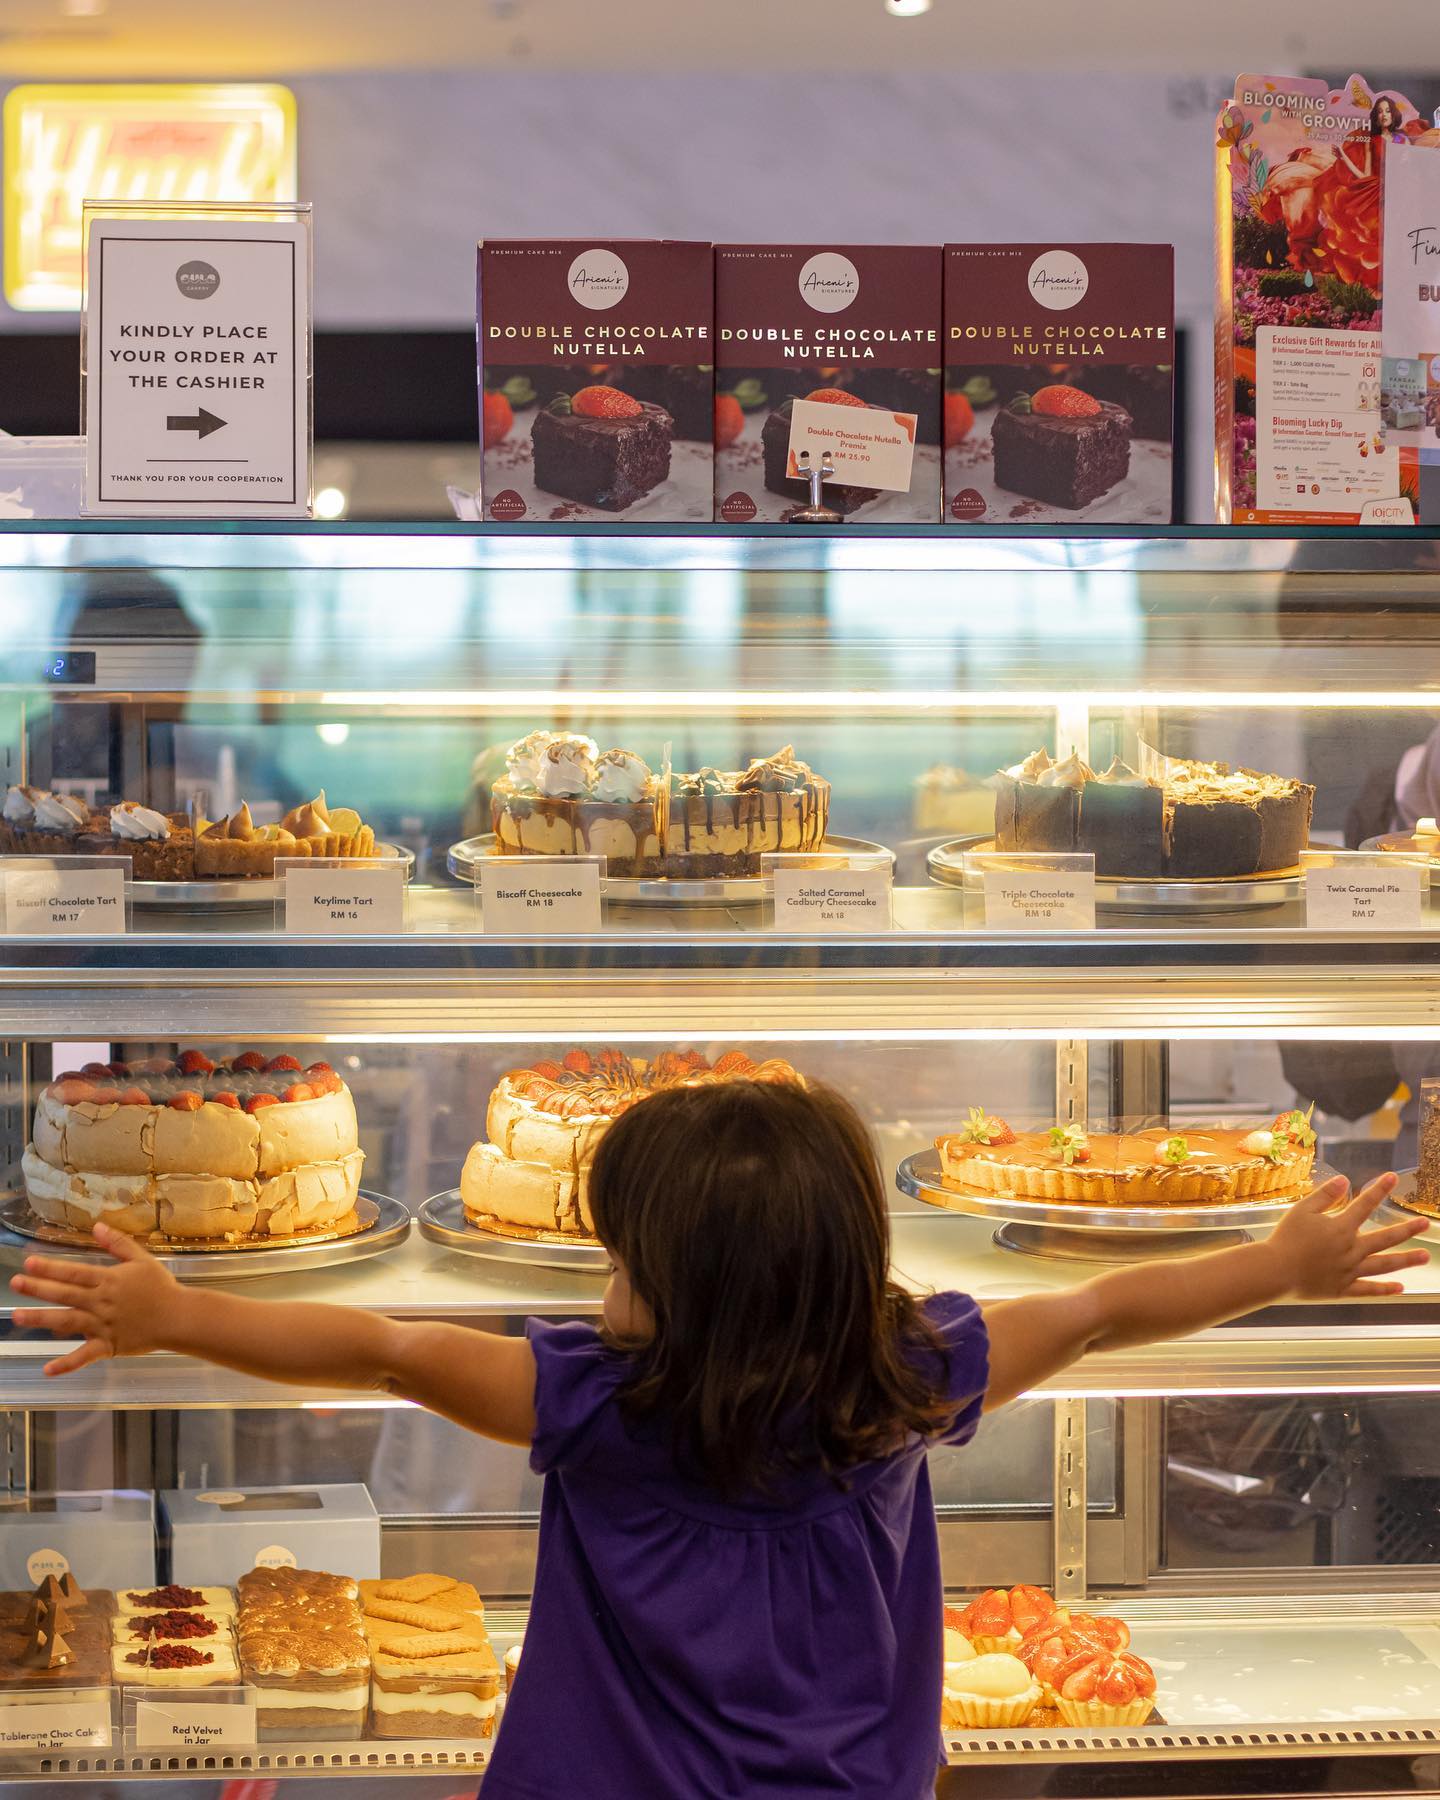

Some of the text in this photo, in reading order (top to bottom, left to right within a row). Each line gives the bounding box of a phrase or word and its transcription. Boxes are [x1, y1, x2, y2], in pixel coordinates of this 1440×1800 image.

[1243, 92, 1326, 111] BLOOMING
[1281, 110, 1302, 118] WITH
[1303, 114, 1372, 131] GROWTH
[120, 324, 268, 339] KINDLY PLACE
[490, 326, 708, 339] DOUBLE CHOCOLATE
[721, 328, 937, 342] DOUBLE CHOCOLATE
[951, 326, 1167, 340] DOUBLE CHOCOLATE
[1272, 335, 1307, 345] Exclusive
[1309, 336, 1323, 346] Gift
[1325, 338, 1355, 348] Rewards
[1358, 339, 1368, 348] for
[554, 343, 645, 355] NUTELLA
[784, 346, 875, 359] NUTELLA
[1013, 343, 1104, 355] NUTELLA
[109, 350, 279, 364] YOUR ORDER AT
[128, 375, 265, 390] THE CASHIER
[1272, 416, 1342, 429] Blooming Lucky Dip
[807, 426, 901, 445] Double Chocolate Nutella
[840, 440, 867, 450] Premix
[835, 451, 870, 461] RM 25.90
[111, 474, 283, 483] THANK YOU FOR YOUR COOPERATION
[497, 888, 582, 899] Biscoff Cheesecake
[799, 889, 865, 897] Salted Caramel
[1001, 889, 1075, 900] Triple Chocolate
[1327, 885, 1400, 893] Twix Caramel Pie
[16, 896, 117, 908] Biscoff Chocolate Tart
[314, 896, 373, 907] Keylime Tart
[526, 899, 540, 907] RM
[787, 897, 876, 907] Cadbury Cheesecake
[1012, 900, 1065, 908] Cheesecake
[1354, 897, 1371, 905] Tart
[52, 913, 79, 922] RM 17
[1368, 910, 1375, 918] 17
[0, 1731, 47, 1741] Toblerone
[50, 1730, 73, 1739] Choc
[172, 1725, 222, 1735] Red Velvet
[49, 1740, 63, 1748] Jar
[184, 1736, 210, 1745] in Jar
